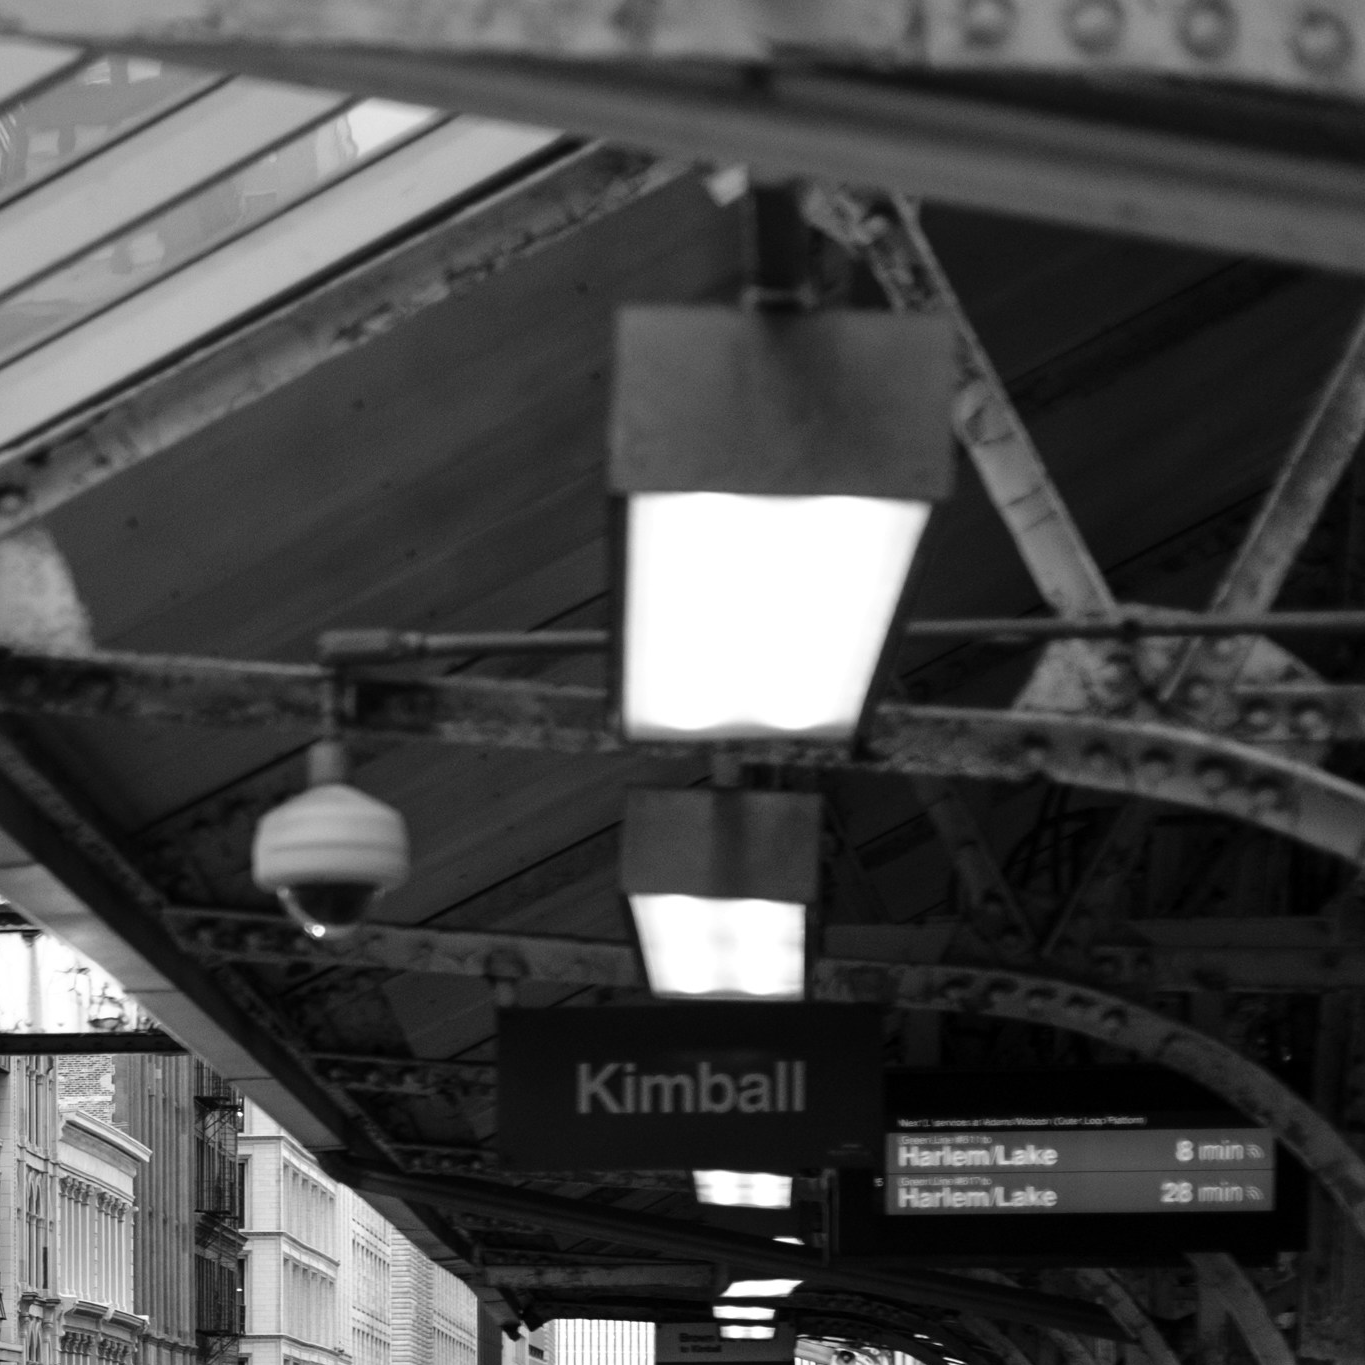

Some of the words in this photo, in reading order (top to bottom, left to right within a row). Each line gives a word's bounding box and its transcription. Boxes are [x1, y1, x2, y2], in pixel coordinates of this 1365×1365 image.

[575, 1060, 807, 1114] Kimball
[898, 1145, 1058, 1166] Harlem/Lake
[1175, 1139, 1194, 1161] 8
[1198, 1140, 1244, 1160] min
[898, 1186, 1058, 1207] Harlem/Lake
[1160, 1181, 1194, 1203] 28
[1197, 1181, 1243, 1202] min
